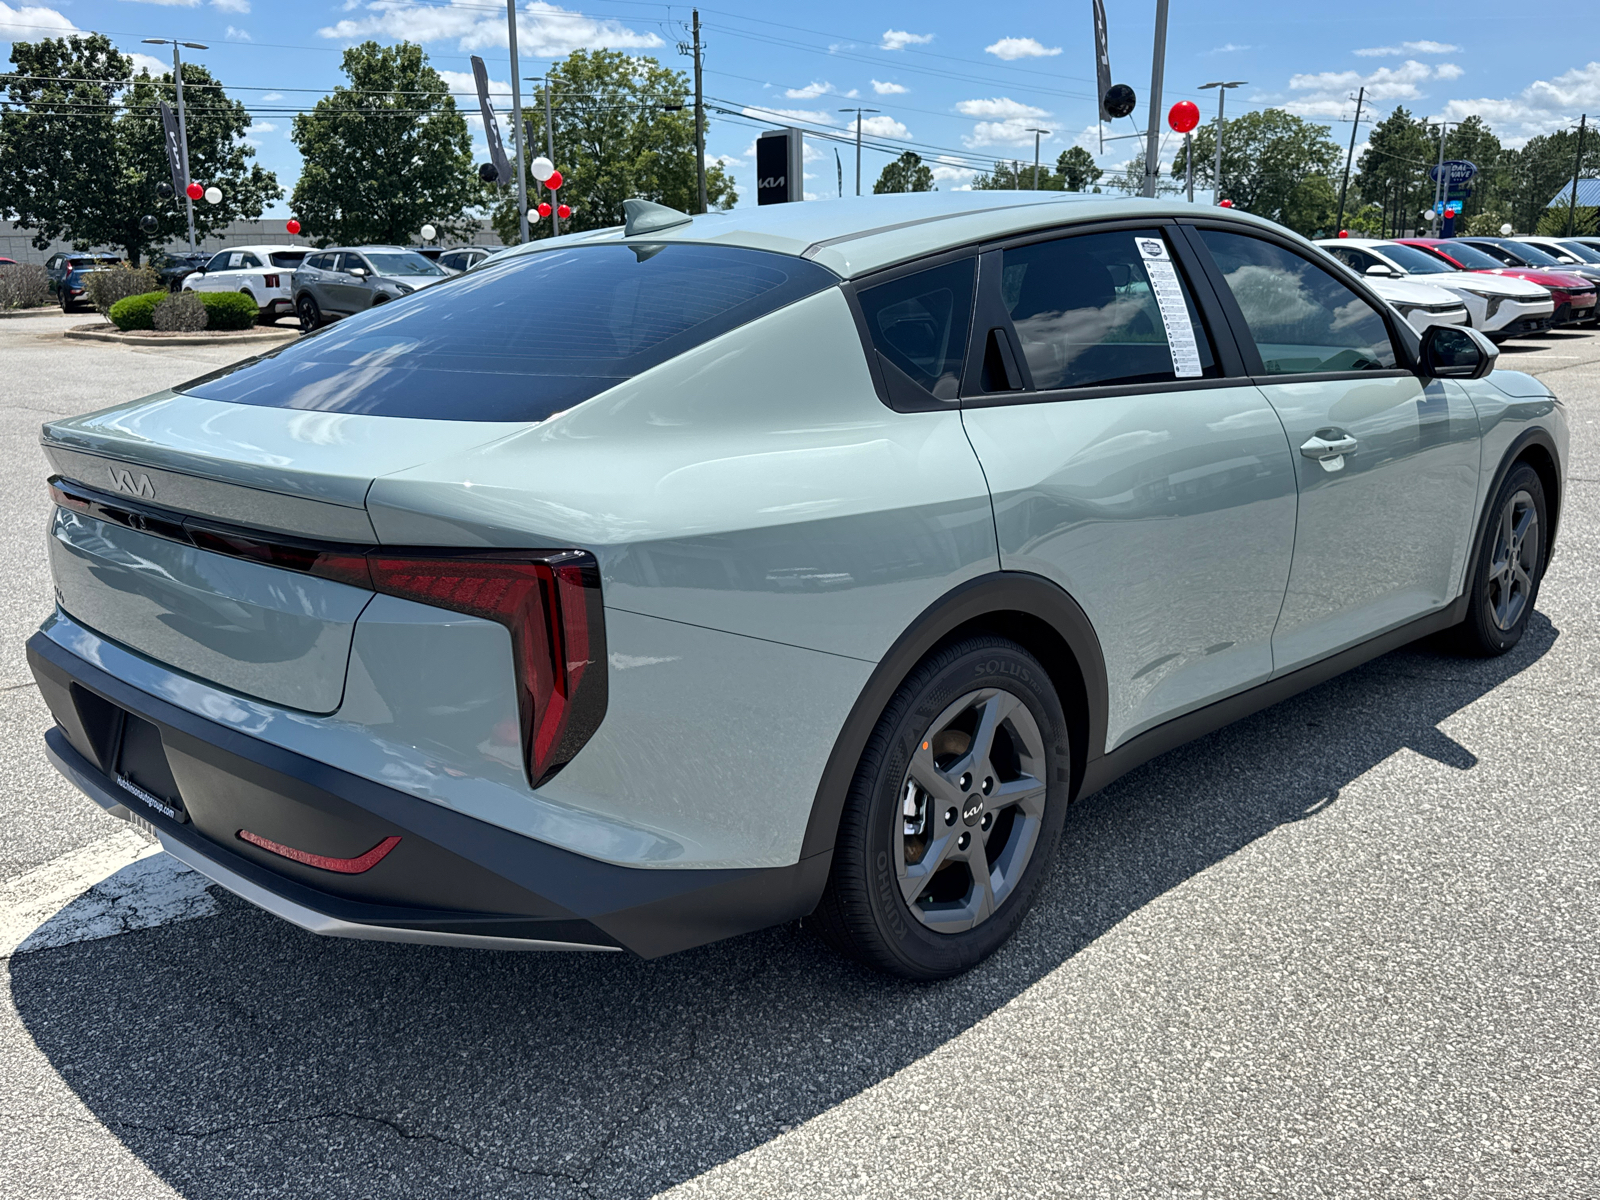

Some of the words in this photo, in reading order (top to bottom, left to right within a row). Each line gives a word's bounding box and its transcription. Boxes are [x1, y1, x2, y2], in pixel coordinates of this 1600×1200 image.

[758, 176, 785, 189] KIA
[107, 466, 156, 499] KIA
[974, 659, 1031, 682] SOLUS
[116, 775, 175, 819] Hutchinsonautogroup.com
[963, 802, 984, 819] KIA
[876, 850, 908, 941] KUMHO
